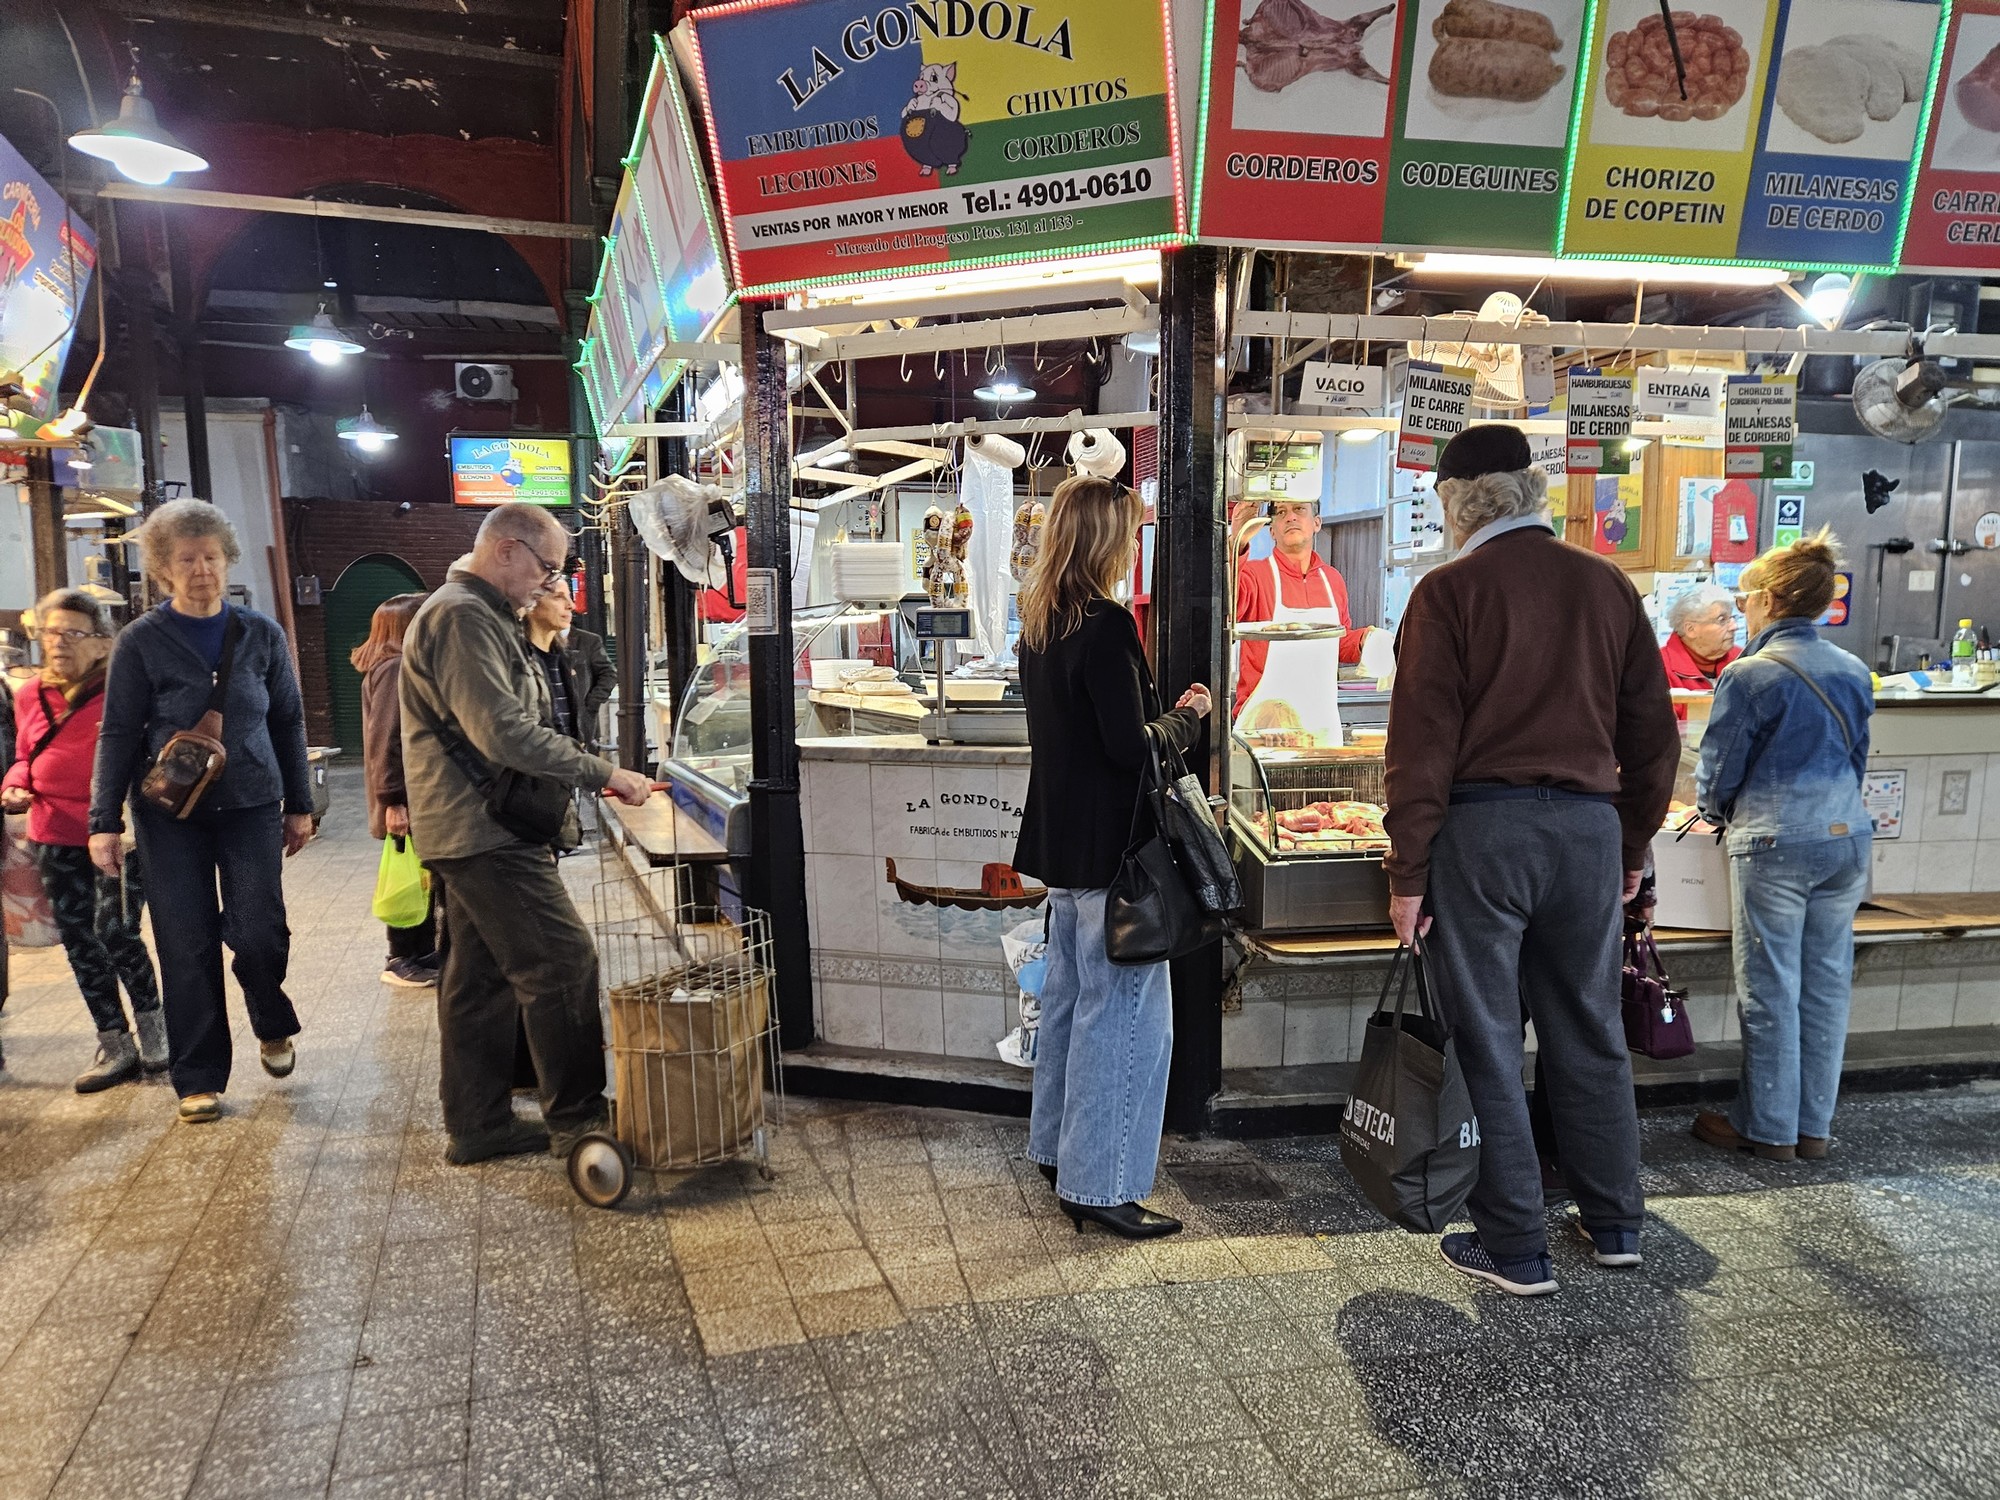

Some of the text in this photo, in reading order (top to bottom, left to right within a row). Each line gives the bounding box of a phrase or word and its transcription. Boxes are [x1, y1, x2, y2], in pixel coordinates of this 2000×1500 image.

[777, 0, 1075, 111] LA GONDOLA
[1006, 77, 1129, 117] CHIVITOS
[746, 114, 881, 157] EMBUTIDOS
[1002, 120, 1141, 163] CORDEROS
[758, 160, 878, 197] LECHONES
[1226, 152, 1379, 185] CORDEROS
[1402, 161, 1559, 194] CODEGUINES
[1605, 166, 1716, 192] CHORIZO
[962, 166, 1152, 215] Tel.: 4901-0610
[1765, 172, 1899, 202] MILANESAS
[751, 200, 949, 238] VENTAS POR MAYOR Y MENOR
[1585, 198, 1725, 225] DE COPETIN
[1767, 206, 1884, 232] DE CERDO
[835, 236, 890, 256] Mercado
[891, 233, 912, 250] del
[913, 226, 970, 252] Progreso
[972, 223, 1006, 242] Ptos.
[1007, 219, 1031, 237] 131
[1034, 218, 1048, 234] al
[1050, 213, 1074, 232] 133
[1315, 377, 1365, 393] VACIO
[1409, 374, 1472, 397] MILANESAS
[1571, 378, 1631, 389] HAMBURGUESAS
[1648, 383, 1711, 398] ENTRAÑA
[1738, 387, 1784, 396] CHORIZO DE
[1411, 395, 1465, 415] DE CARRE
[1570, 404, 1630, 417] MILANESAS
[1730, 397, 1792, 405] CORDERO PREMIUM
[1757, 407, 1761, 415] Y
[1408, 414, 1463, 434] DE CERDO
[1570, 421, 1630, 436] DE CERDO
[1728, 416, 1792, 429] MILANESAS
[1544, 436, 1549, 446] Y
[1728, 431, 1791, 443] DE CORDERO
[472, 440, 550, 459] LA GONDOLA
[906, 793, 1024, 818] LA GONDOLA
[910, 825, 940, 836] FABRICA
[941, 827, 950, 837] de
[953, 827, 998, 839] EMBUTIDOS
